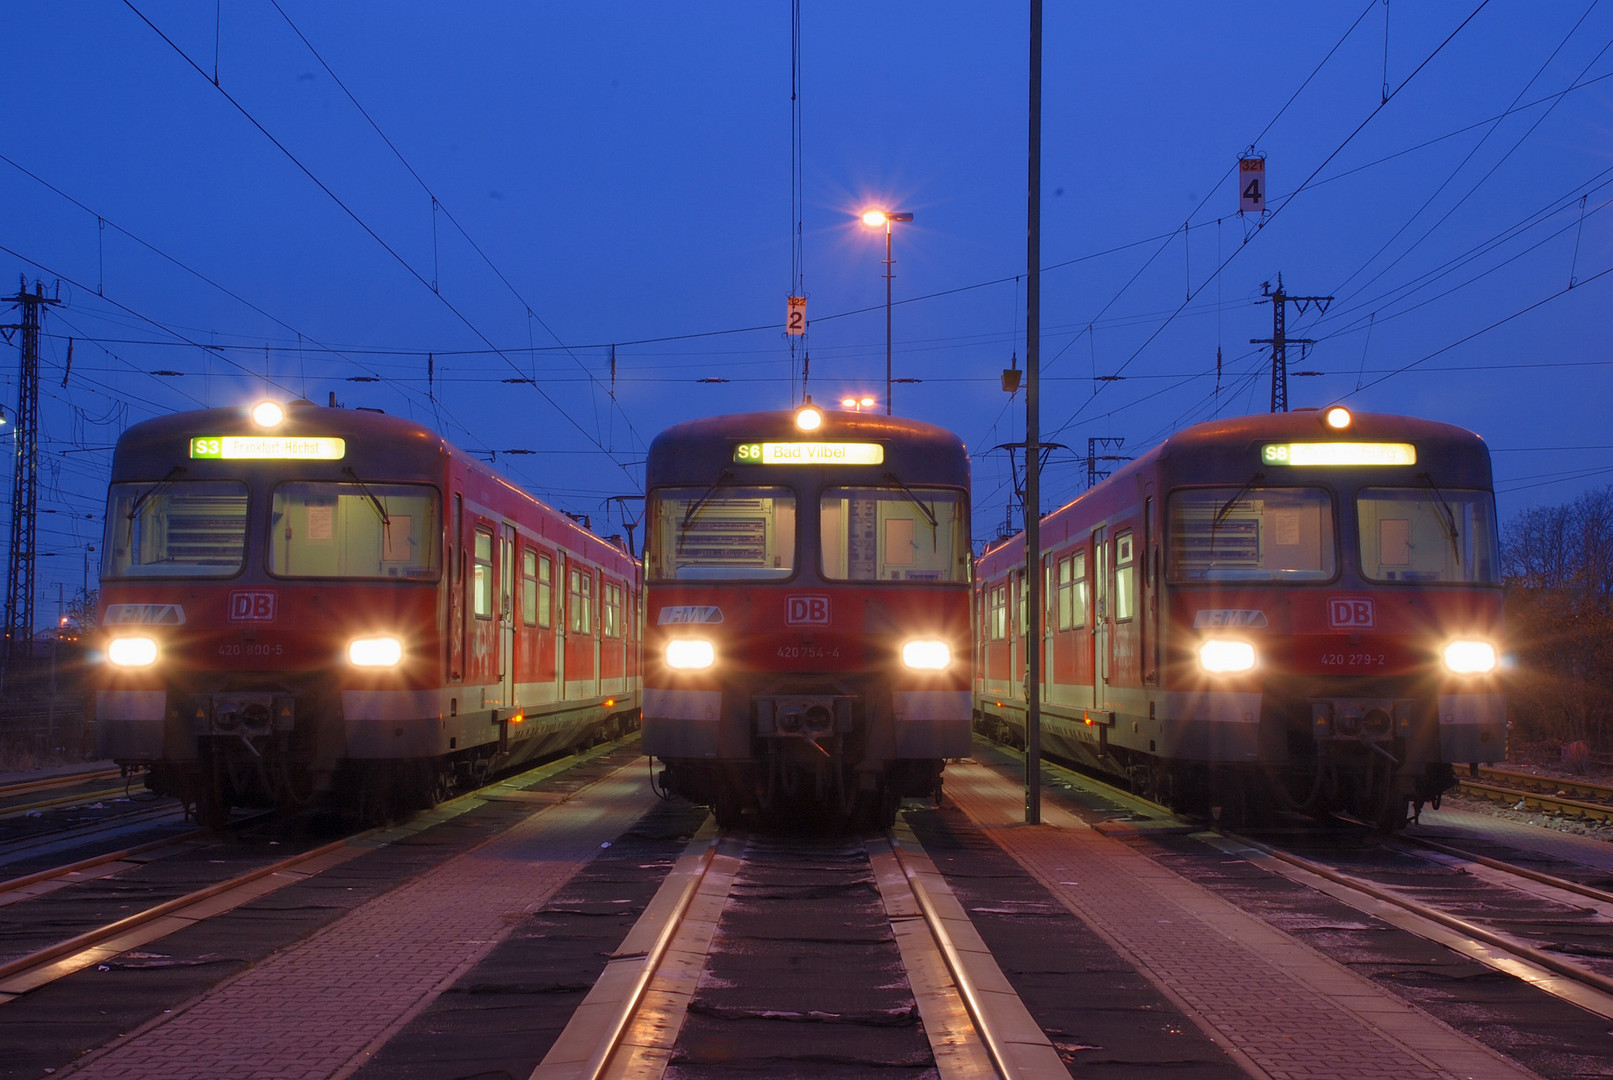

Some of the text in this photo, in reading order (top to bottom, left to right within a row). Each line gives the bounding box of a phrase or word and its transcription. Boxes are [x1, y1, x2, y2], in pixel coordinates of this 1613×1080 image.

[1242, 160, 1263, 170] 321
[1243, 179, 1262, 204] 4
[789, 311, 803, 329] 2
[196, 440, 219, 454] S3
[738, 445, 846, 459] S6 Bad Vilbel
[232, 593, 273, 619] DB
[789, 598, 828, 622] DB
[1332, 601, 1372, 625] DB
[218, 644, 240, 656] 420
[1321, 654, 1385, 665] 420 279-2
